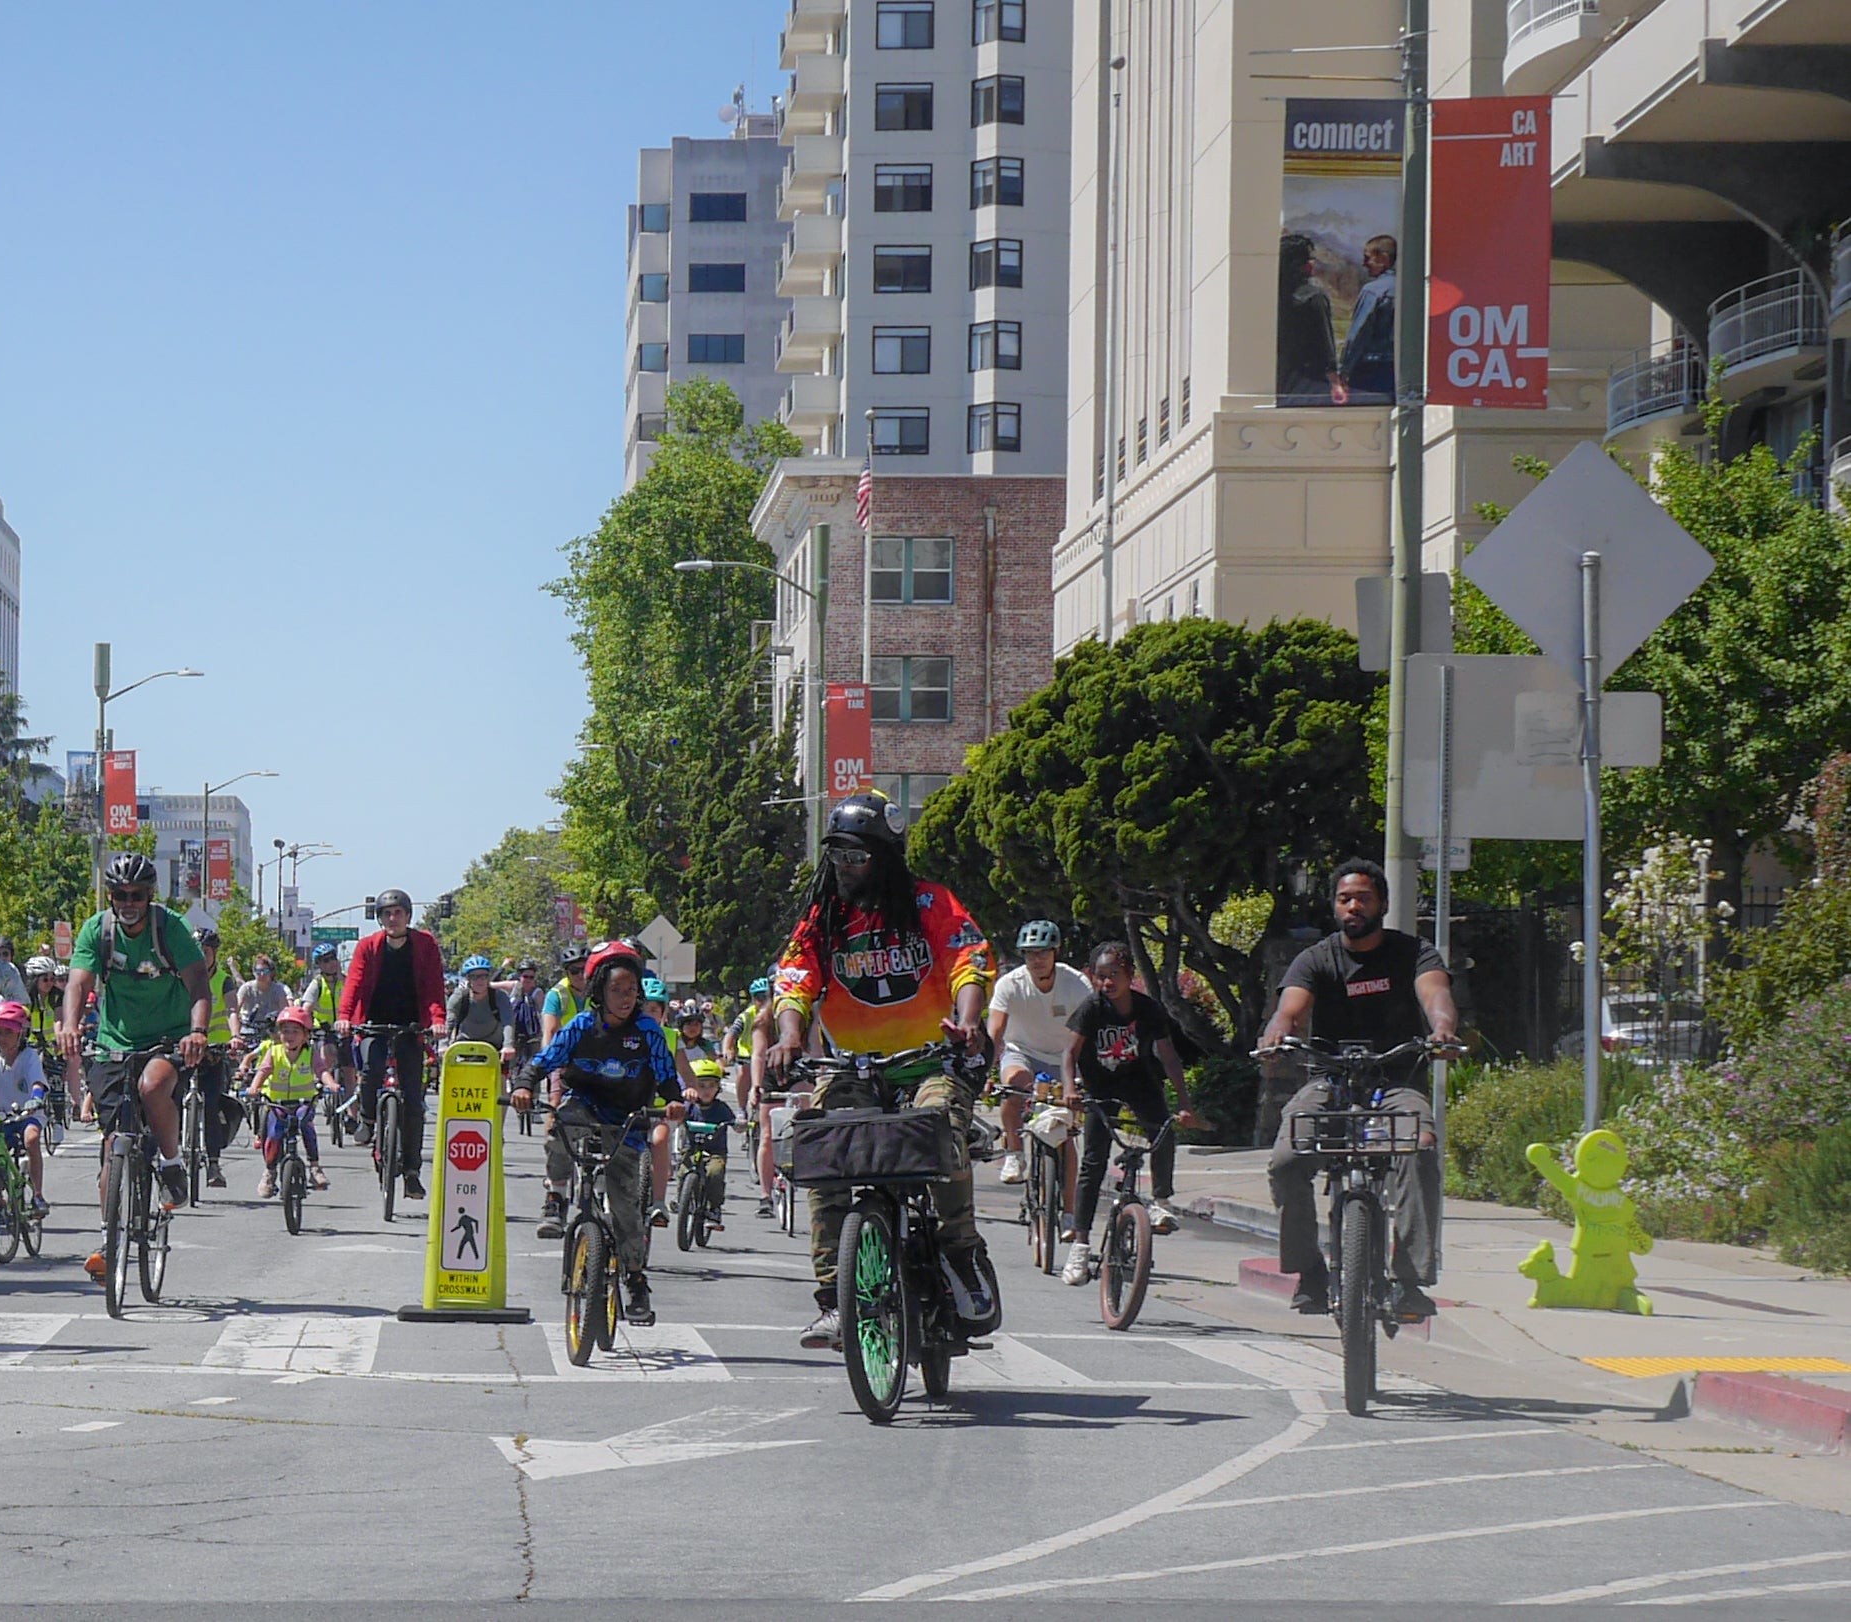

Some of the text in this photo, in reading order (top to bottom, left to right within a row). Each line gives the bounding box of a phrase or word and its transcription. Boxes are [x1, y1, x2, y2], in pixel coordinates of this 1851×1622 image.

[1512, 109, 1537, 136] CA
[1293, 118, 1394, 151] connect
[1500, 141, 1537, 167] ART
[1449, 304, 1529, 346] OM
[834, 758, 864, 775] OM
[110, 804, 132, 818] OM
[211, 879, 227, 888] OM
[451, 1087, 489, 1099] STATE
[456, 1101, 483, 1113] LAW
[449, 1142, 487, 1160] STOP
[456, 1183, 477, 1195] FOR
[448, 1273, 479, 1283] WITHIN
[438, 1284, 487, 1296] CROSSWALK
